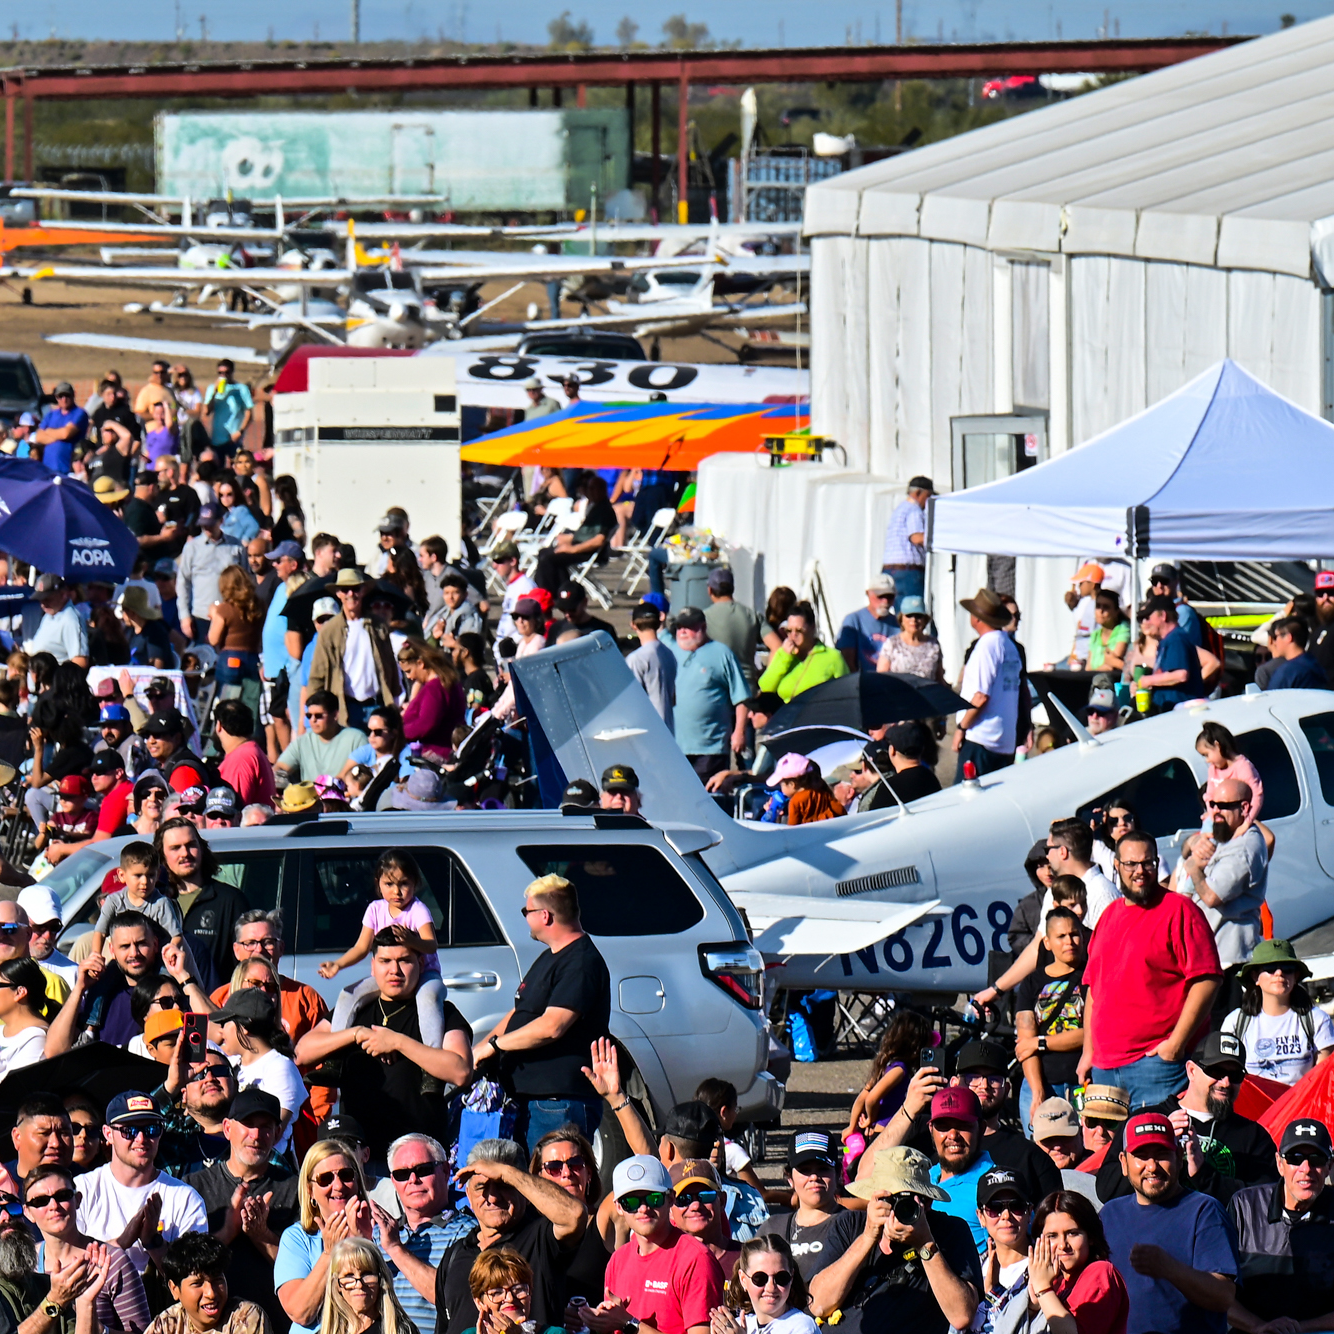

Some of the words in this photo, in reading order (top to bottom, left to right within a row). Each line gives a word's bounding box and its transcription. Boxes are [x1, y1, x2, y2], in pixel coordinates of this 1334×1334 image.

[469, 356, 698, 390] 830
[71, 549, 115, 567] AOPA
[1276, 1035, 1300, 1044] FLY-IN
[1276, 1043, 1302, 1055] 2023
